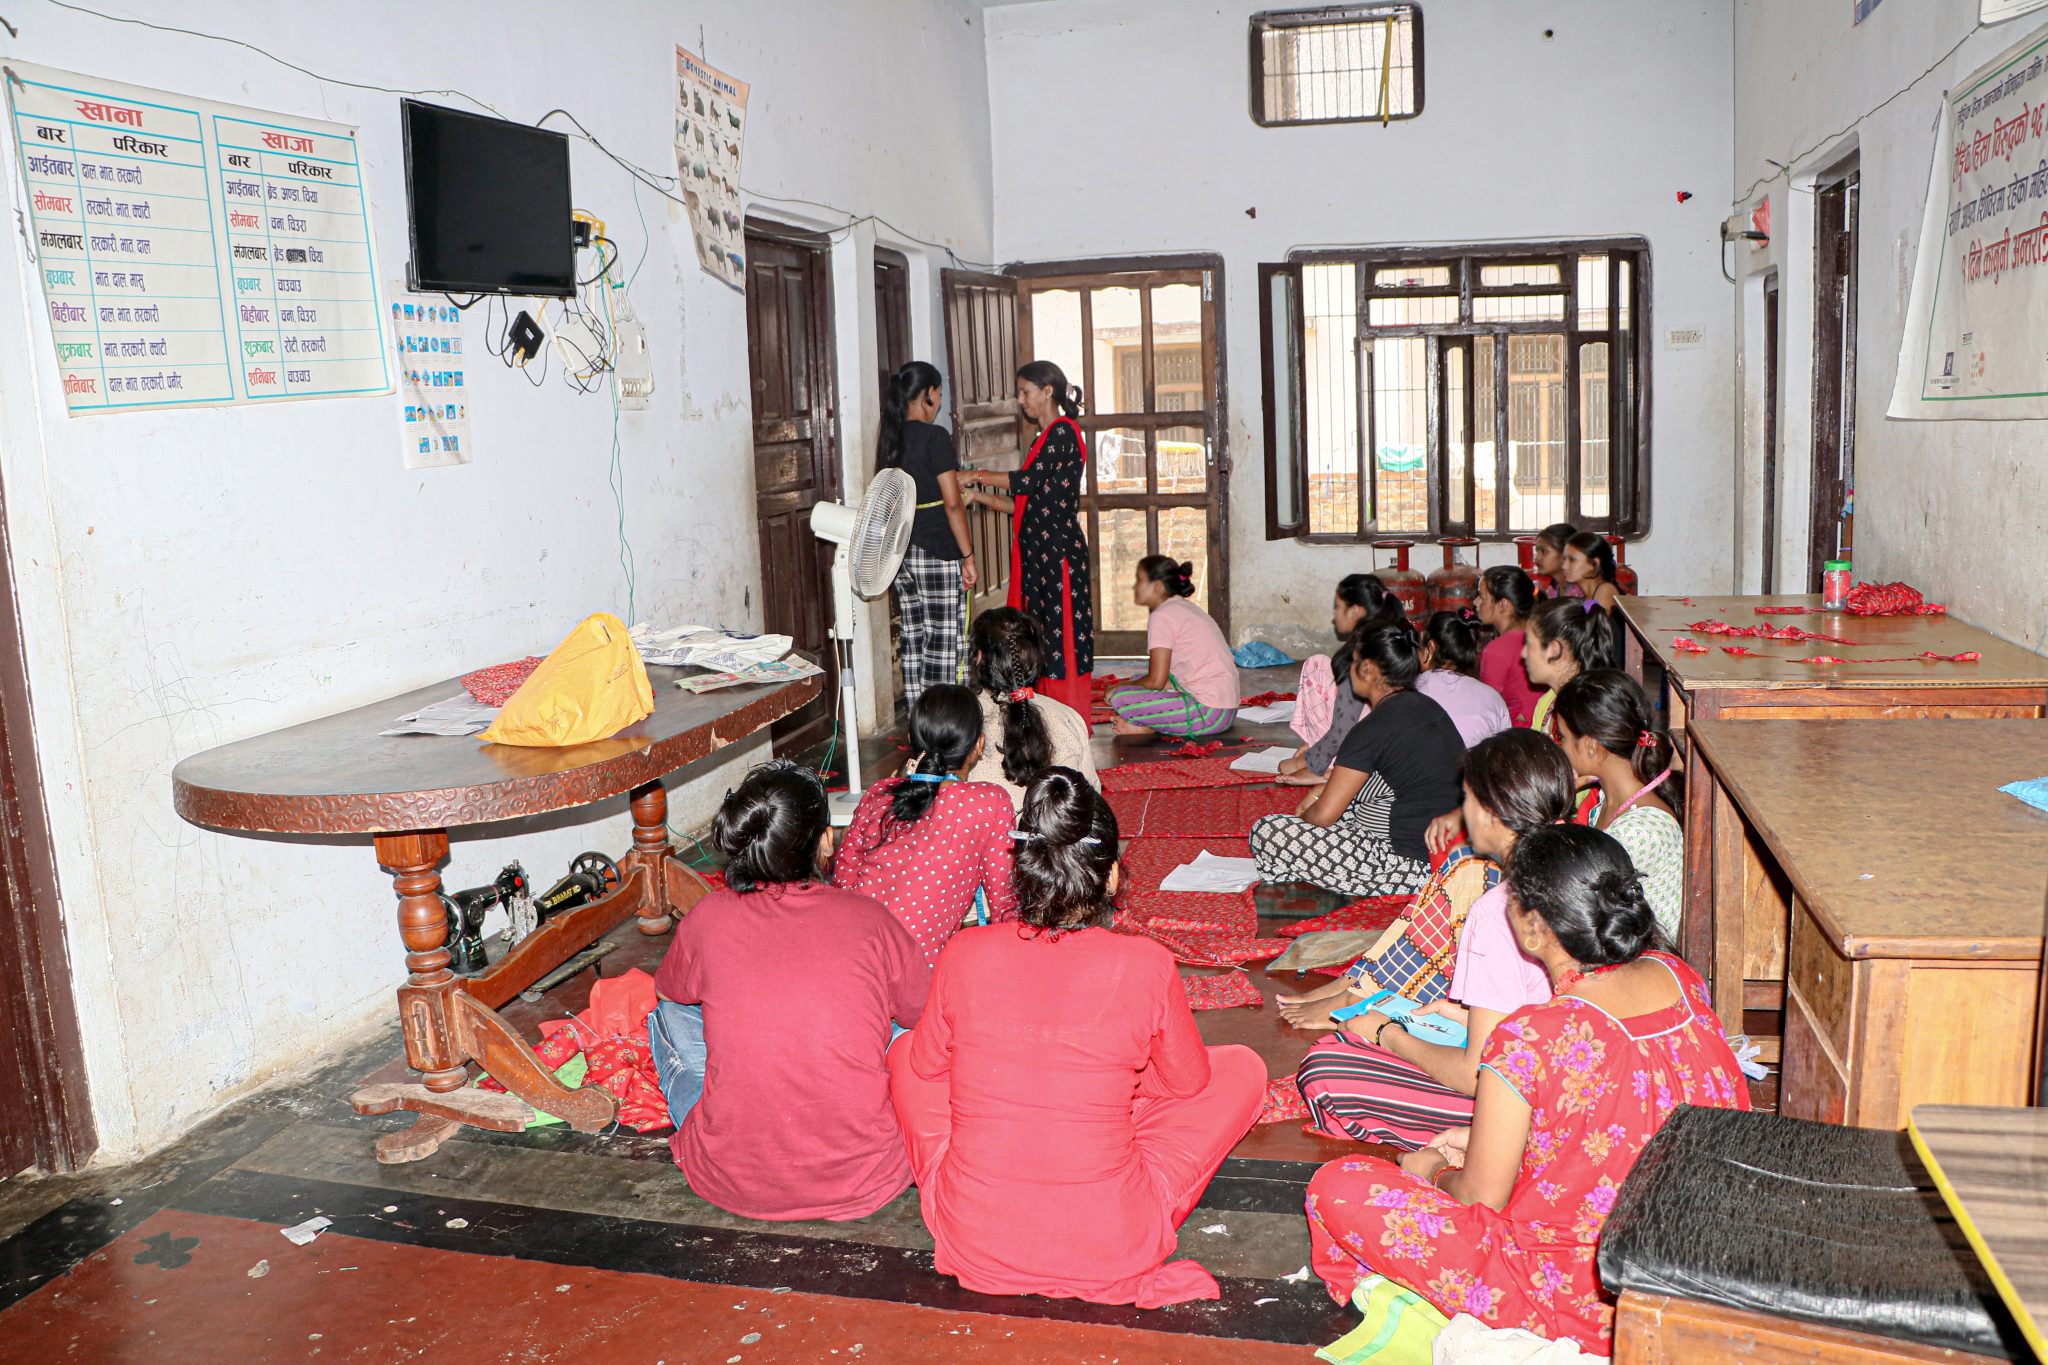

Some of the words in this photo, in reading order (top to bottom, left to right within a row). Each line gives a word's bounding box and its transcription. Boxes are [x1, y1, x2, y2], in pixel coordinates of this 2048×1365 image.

[685, 60, 712, 84] DOMESTIC
[713, 77, 736, 97] ANIMAL
[74, 99, 143, 128] खाना
[36, 125, 66, 143] बार
[112, 135, 168, 158] परिकार
[260, 130, 315, 154] खाजा
[28, 154, 75, 178] आईतबार
[117, 165, 143, 185] तरकारी
[228, 153, 252, 169] बार
[287, 160, 333, 180] परिकार
[226, 179, 261, 198] आईतबार
[302, 185, 319, 204] चिया
[33, 189, 73, 213] सोमबार
[230, 209, 259, 229] सोमबार
[287, 214, 307, 233] चिउरा
[39, 229, 84, 251] मंगलबार
[137, 238, 151, 255] दाल
[233, 243, 268, 261] मंगलबार
[308, 246, 324, 264] चिया
[45, 269, 76, 289] बुधबार
[129, 273, 146, 292] मासु
[237, 277, 262, 295] बुधबार
[277, 278, 303, 293] चाउचाउ
[51, 301, 87, 323] बिहीबार
[134, 304, 160, 323] तरकारी
[240, 305, 270, 324] बिहीबार
[297, 305, 317, 324] चिउरा
[57, 342, 93, 363] शुक्रबार
[244, 339, 275, 358] शुक्रबार
[301, 336, 327, 353] तरकारी
[63, 374, 97, 396] शनिबार
[248, 367, 277, 387] शनिबार
[287, 369, 311, 383] चाउचाउ
[551, 888, 573, 905] BHARAT
